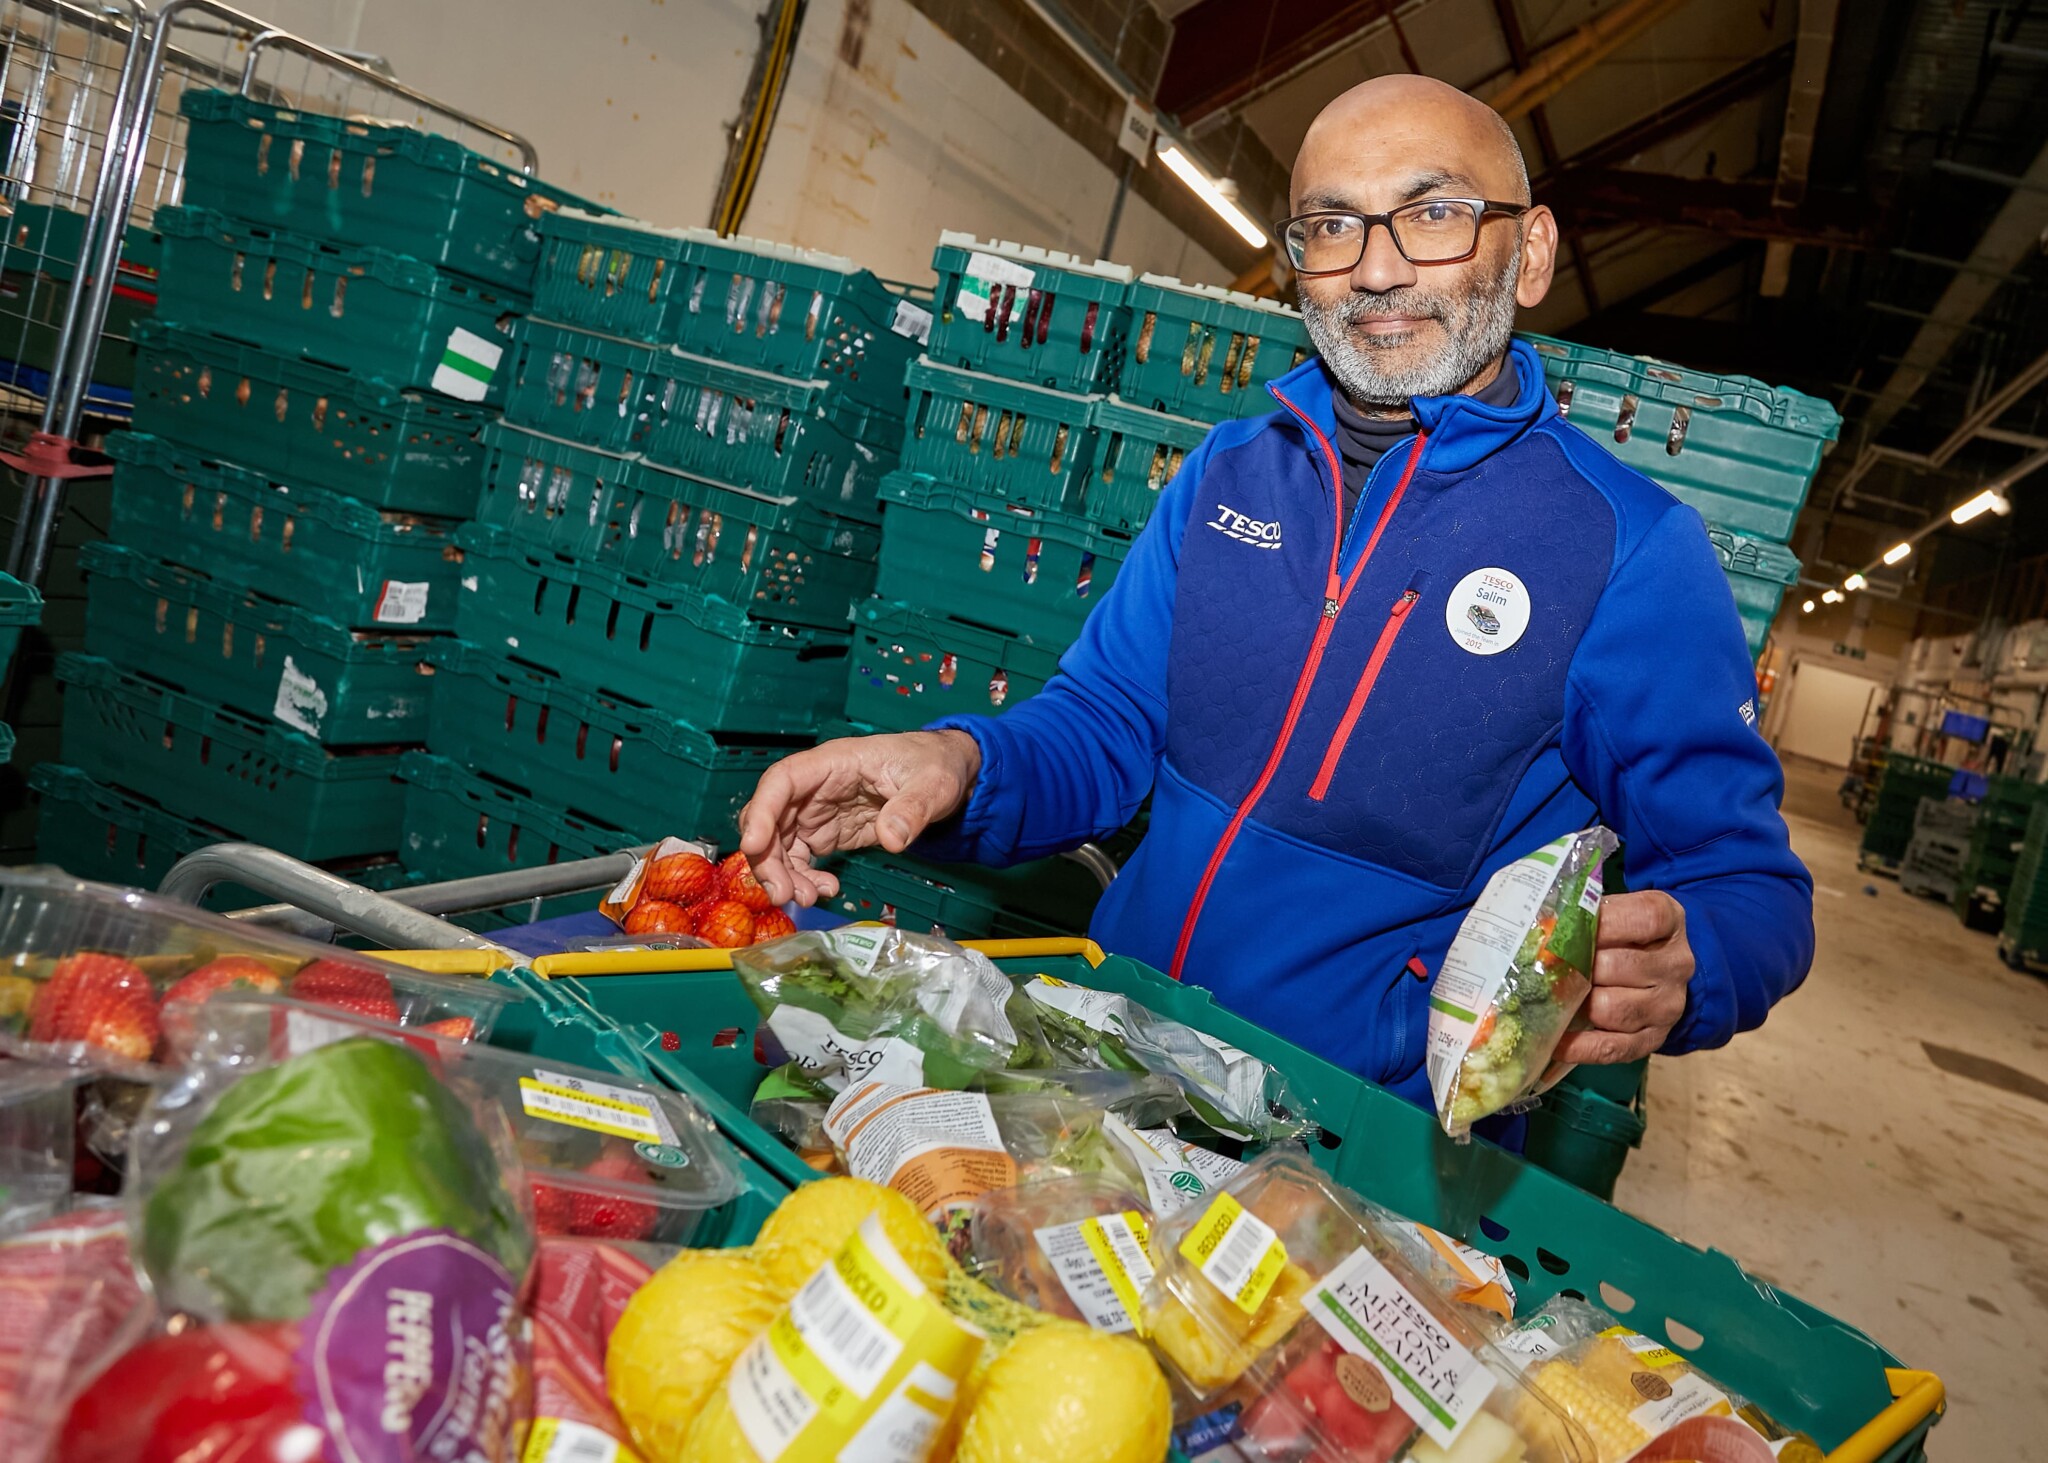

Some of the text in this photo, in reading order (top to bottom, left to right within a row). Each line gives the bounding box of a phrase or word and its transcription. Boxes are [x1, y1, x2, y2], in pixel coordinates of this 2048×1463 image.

[1216, 504, 1282, 541] TESCO
[1475, 587, 1508, 606] Salim
[1483, 574, 1514, 590] TESCO
[1465, 638, 1482, 650] 2012
[824, 1033, 885, 1067] TESCO
[1437, 1030, 1453, 1047] 225g
[1196, 1212, 1234, 1258] REDUCED
[1357, 1283, 1459, 1388] MELON &
[1394, 1291, 1451, 1351] TESCO
[381, 1287, 434, 1434] PEPPERS
[1336, 1282, 1463, 1412] PINEAPPLE
